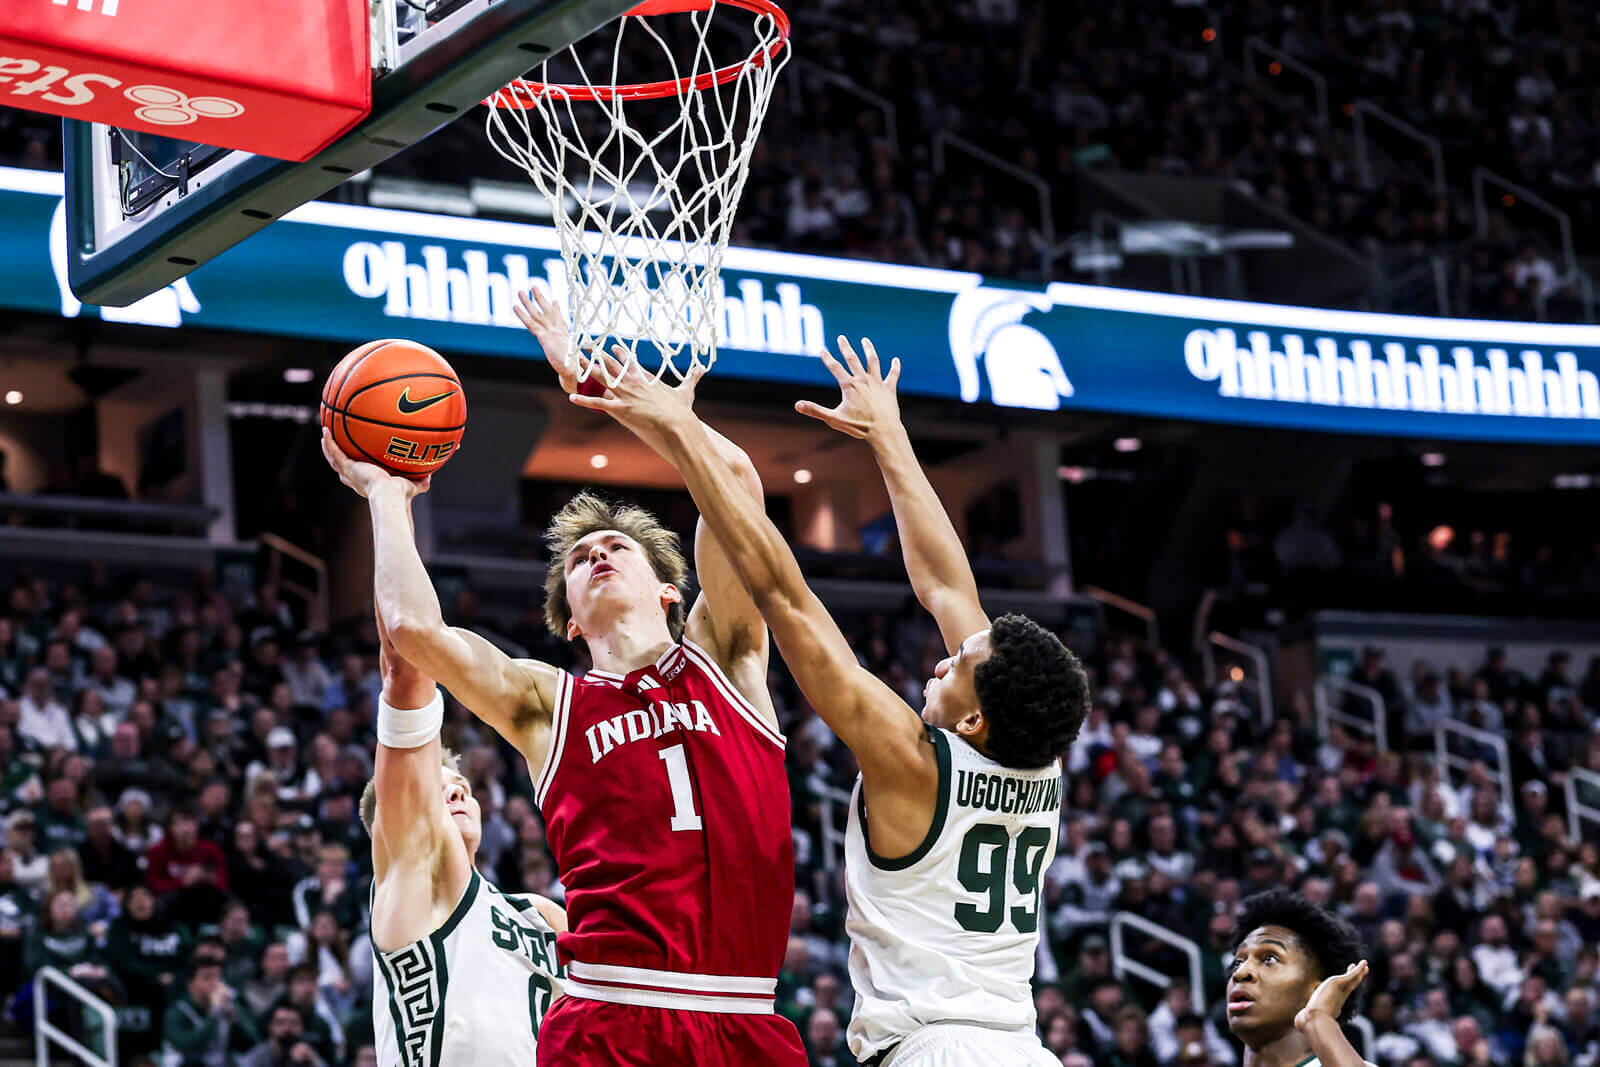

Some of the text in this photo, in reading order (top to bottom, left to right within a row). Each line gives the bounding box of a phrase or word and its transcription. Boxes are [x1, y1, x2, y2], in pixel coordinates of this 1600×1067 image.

[386, 436, 455, 461] ELITE
[585, 700, 722, 765] INDIANA
[658, 743, 703, 832] 1
[954, 822, 1051, 934] 99
[490, 905, 569, 980] STAT
